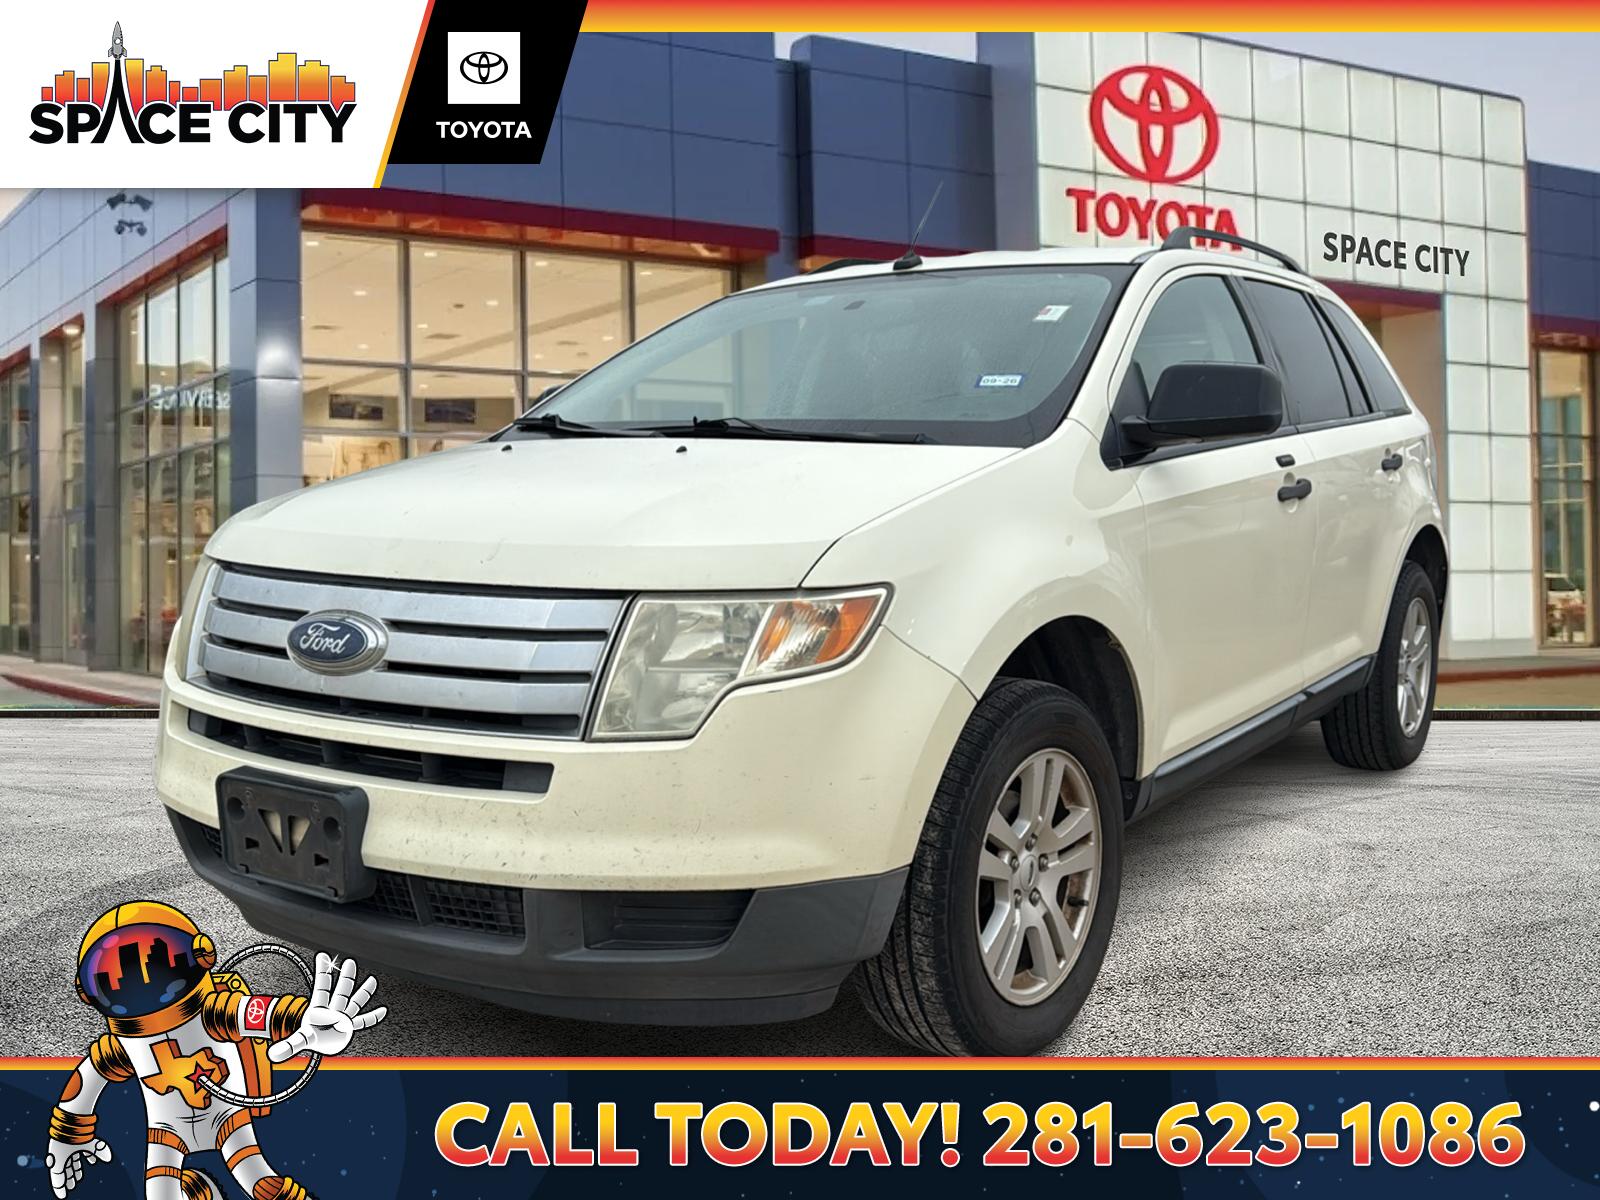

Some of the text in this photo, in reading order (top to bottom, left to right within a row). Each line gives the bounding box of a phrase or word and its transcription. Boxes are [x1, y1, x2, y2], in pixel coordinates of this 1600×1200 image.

[1065, 187, 1243, 252] TOYOTA
[1323, 231, 1470, 277] SPACE CITY
[300, 622, 351, 654] Ford
